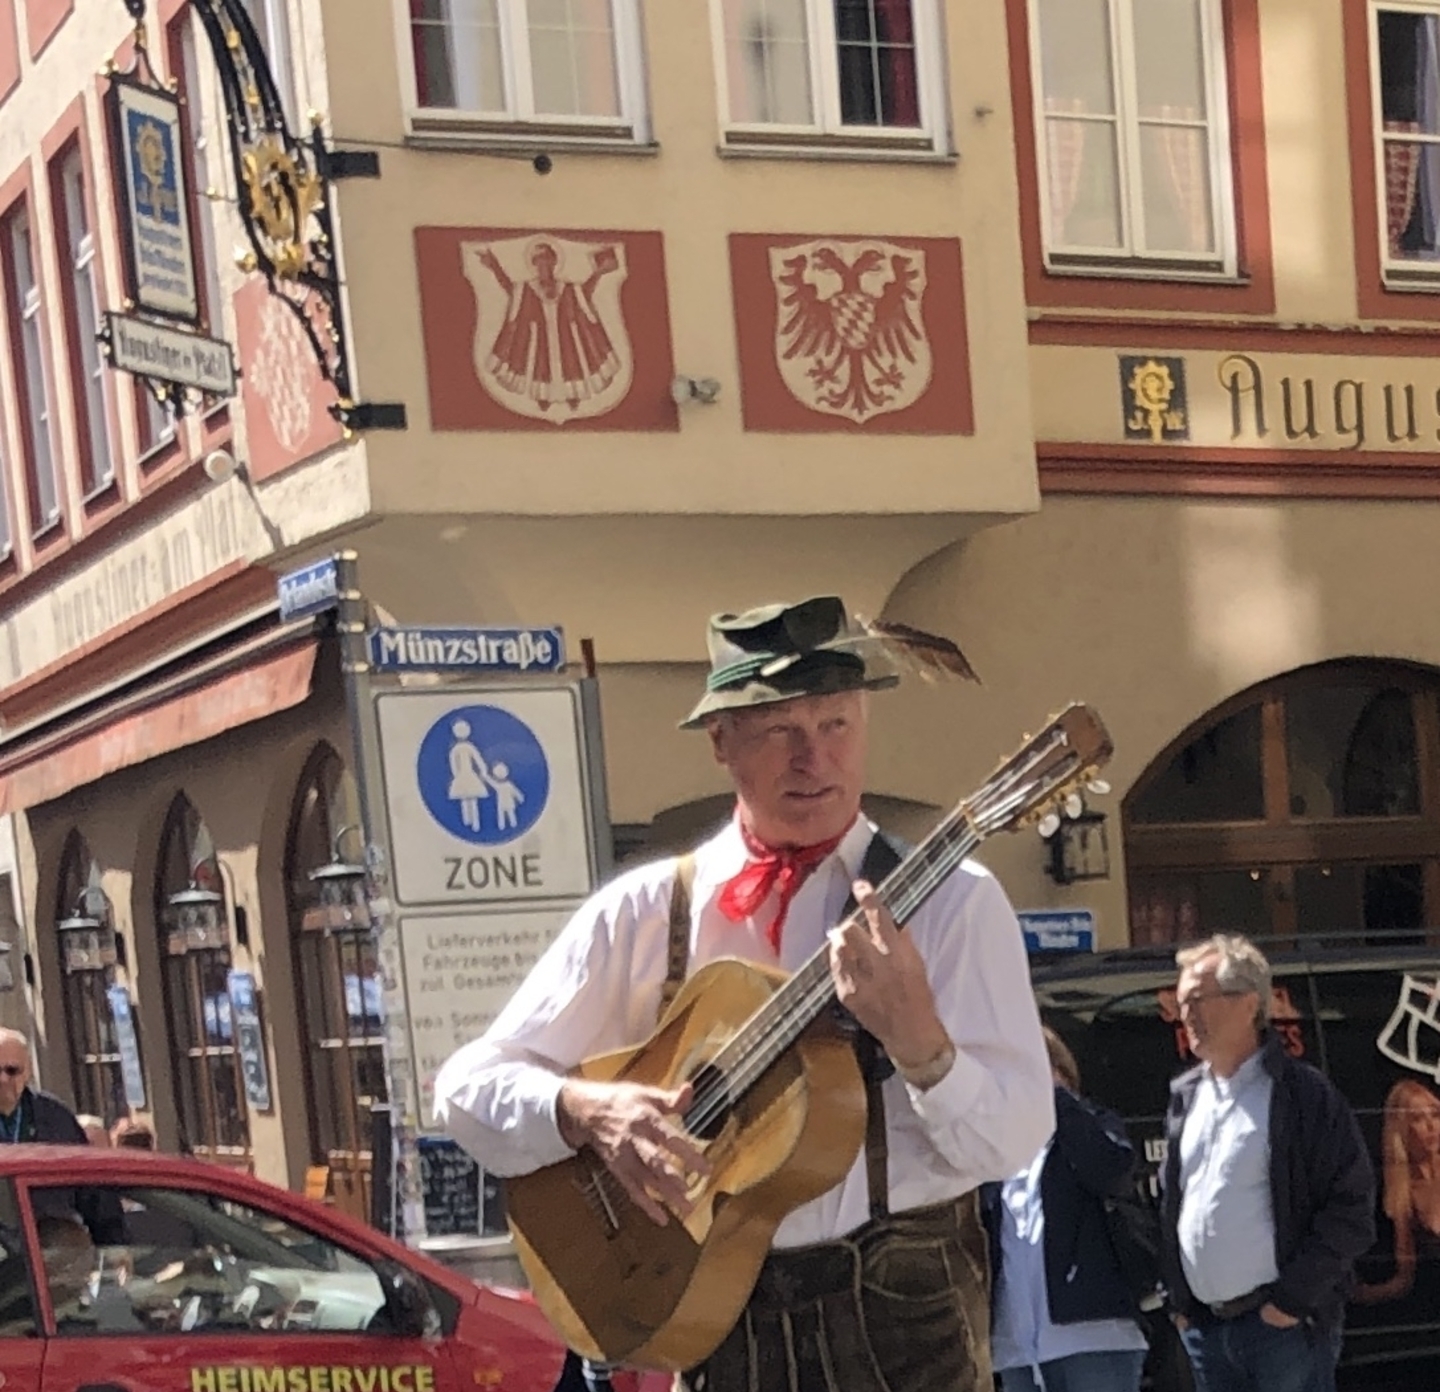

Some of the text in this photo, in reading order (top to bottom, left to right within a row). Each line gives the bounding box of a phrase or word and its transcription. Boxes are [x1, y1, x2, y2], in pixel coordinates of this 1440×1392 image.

[1217, 354, 1440, 450] Augu
[379, 631, 552, 669] Münzstraße
[444, 853, 543, 890] ZONE
